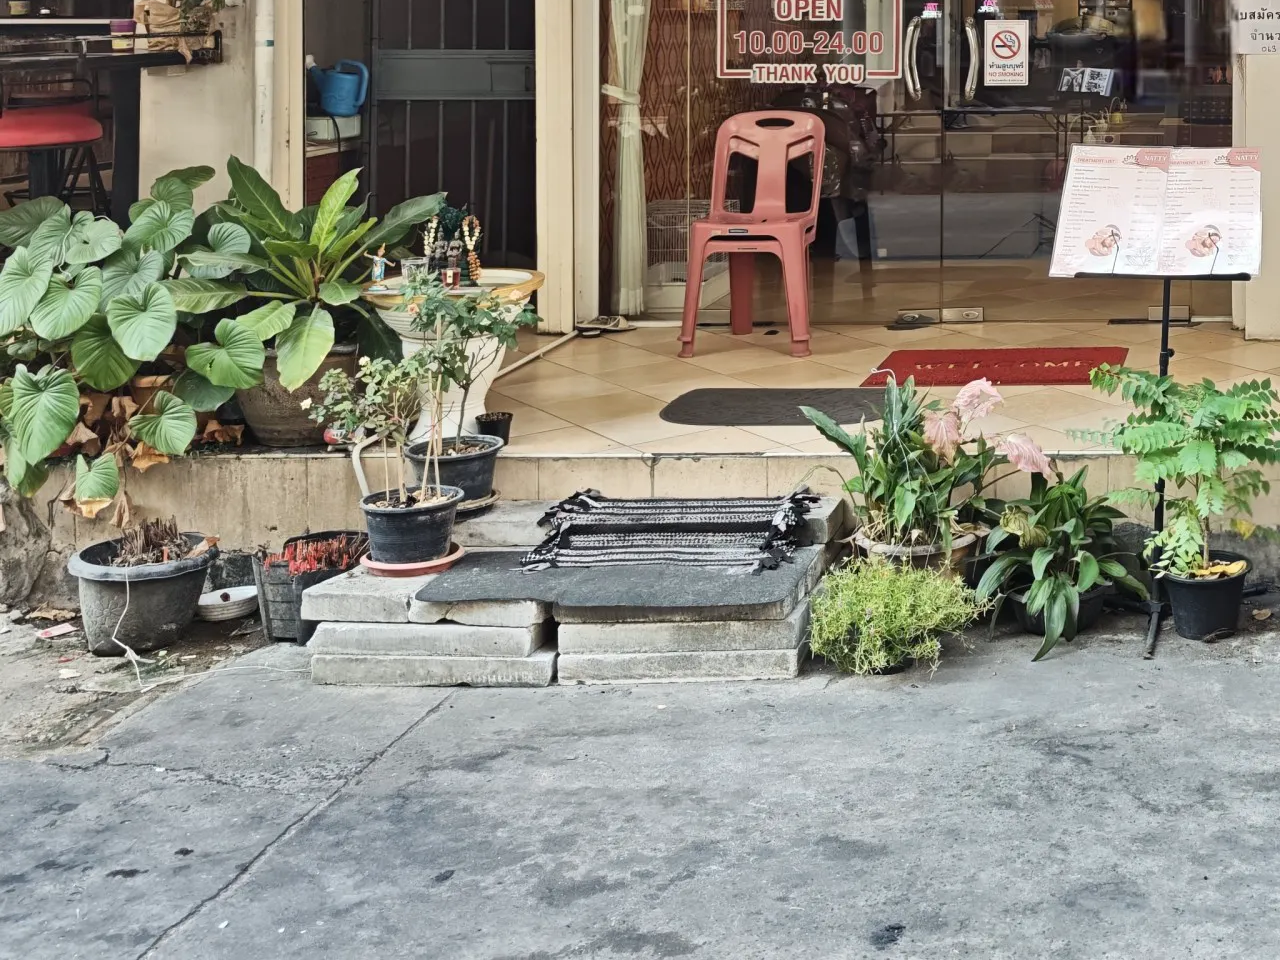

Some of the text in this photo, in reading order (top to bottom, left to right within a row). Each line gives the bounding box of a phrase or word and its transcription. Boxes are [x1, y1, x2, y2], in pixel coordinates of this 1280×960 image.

[733, 30, 885, 55] 10.00-24.00
[754, 64, 864, 83] THANK YOU
[1235, 154, 1258, 162] NATTY
[914, 360, 1096, 370] WELCOME
